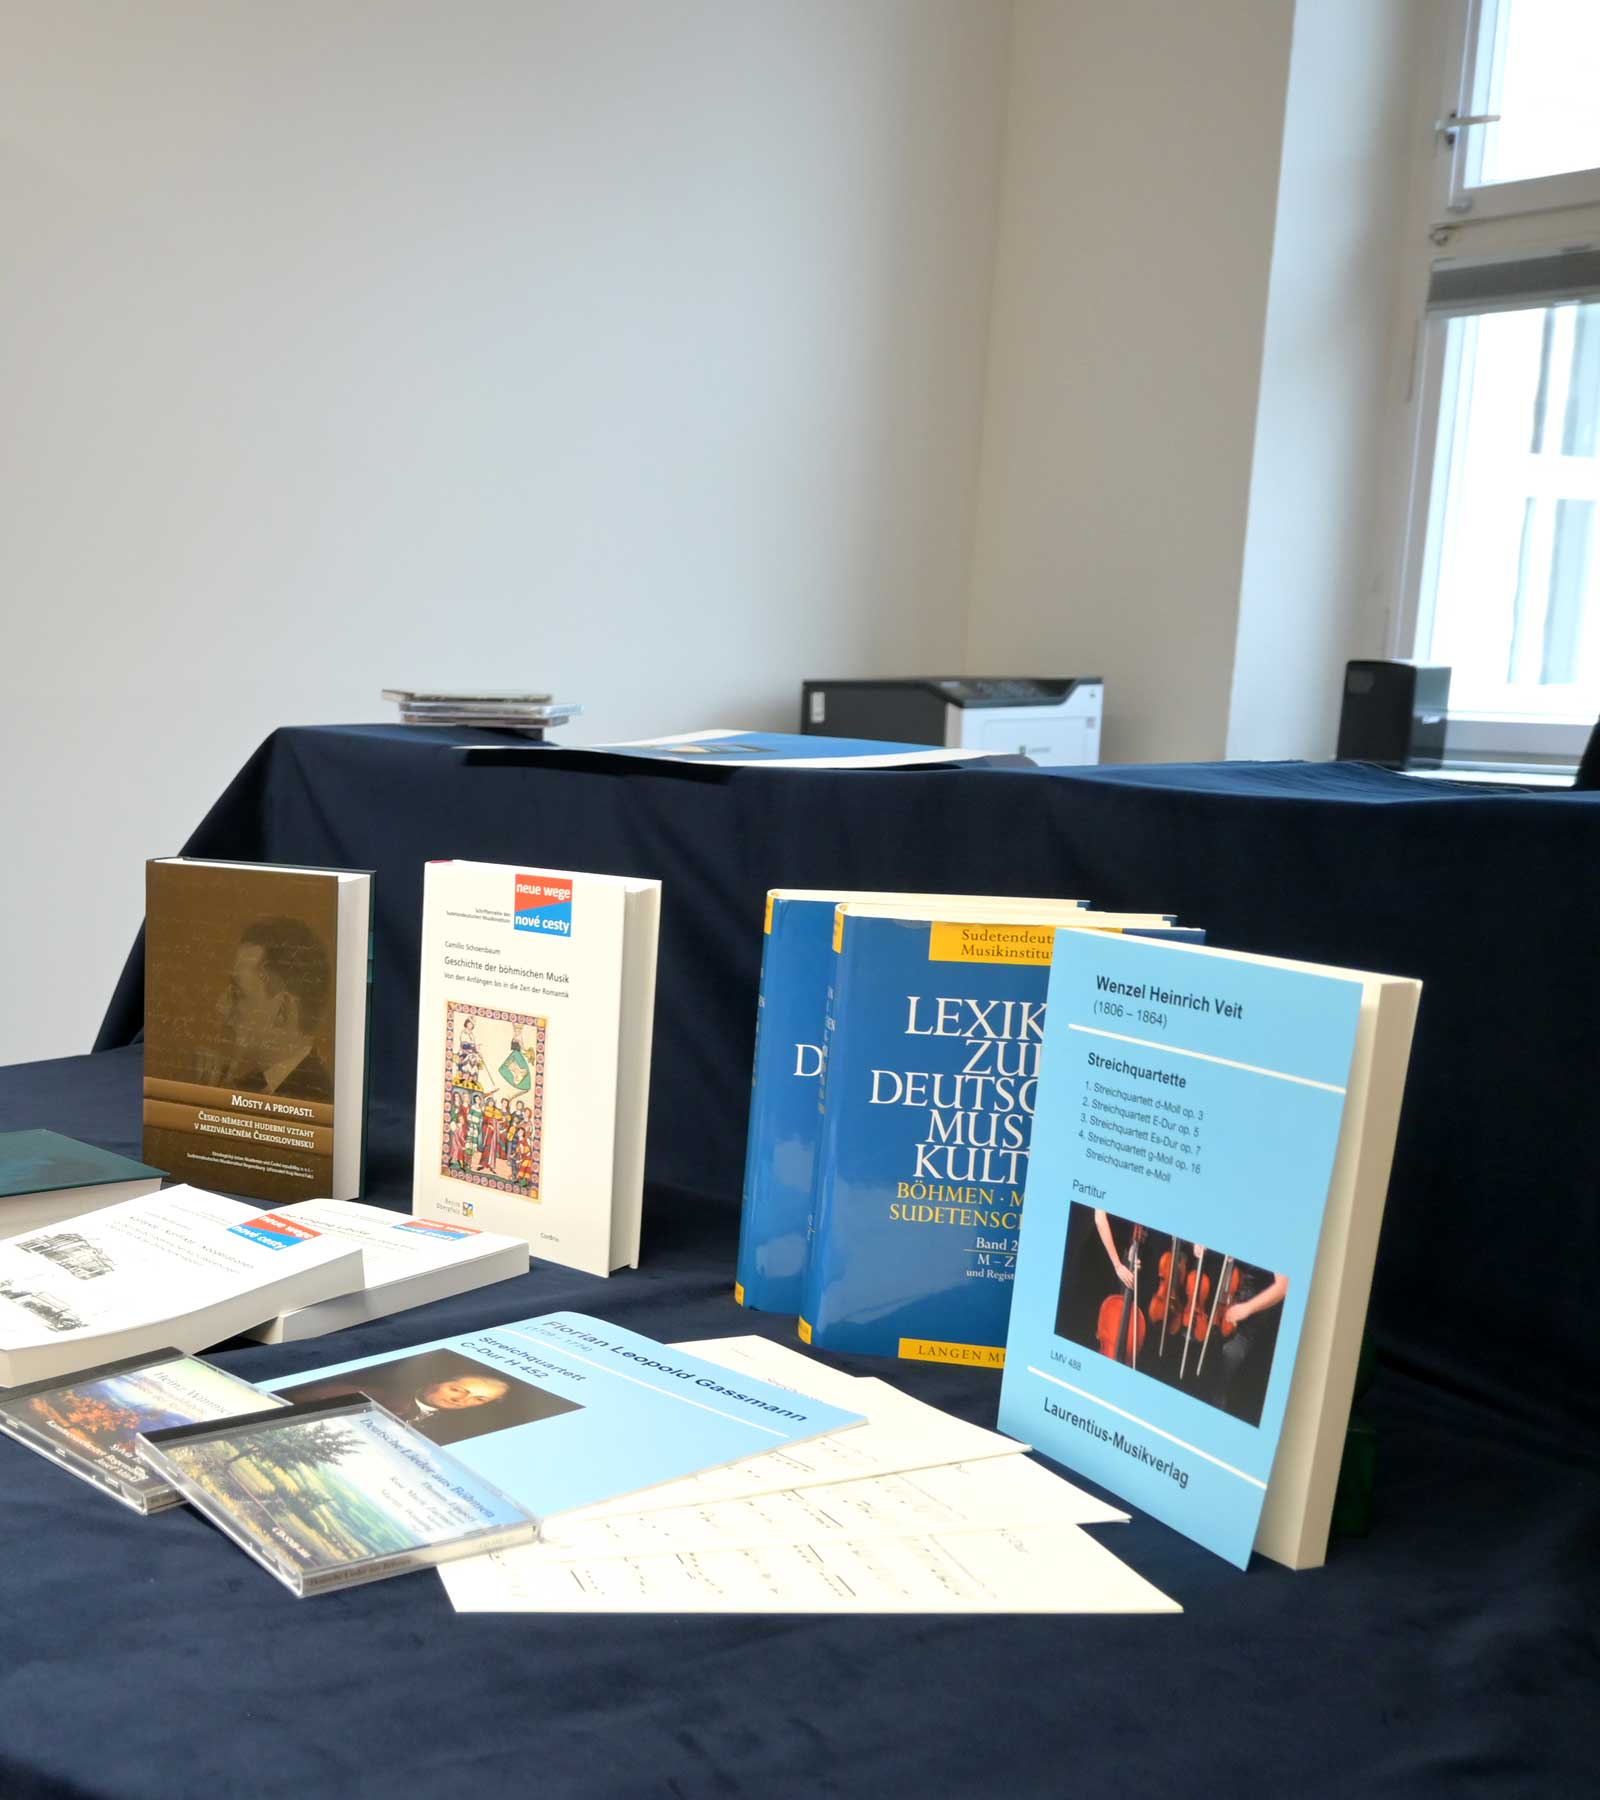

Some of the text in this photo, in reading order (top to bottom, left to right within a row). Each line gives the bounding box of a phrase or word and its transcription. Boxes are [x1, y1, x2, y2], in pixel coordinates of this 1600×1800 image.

[516, 884, 570, 901] neue wege
[515, 915, 569, 934] nové cesty
[444, 956, 570, 984] Geschichte der böhmischen Musik
[467, 976, 493, 987] Anfängen
[510, 982, 518, 990] die
[520, 984, 531, 992] Zeit
[531, 986, 541, 994] der
[542, 988, 569, 998] Romantik
[1096, 975, 1243, 1020] Wenzel Heinrich Veit
[904, 996, 1048, 1042] LEXIK
[1093, 999, 1124, 1018] (1806
[1136, 1009, 1168, 1030] 1864)
[1088, 1052, 1187, 1089] Streichquartette
[264, 1103, 272, 1112] A
[1082, 1096, 1199, 1138] 2. Streichquartett E-Dur op. 5
[1085, 1081, 1204, 1121] 1. Streichquartett d-Moll op. 3
[194, 1122, 200, 1130] V
[253, 1129, 315, 1149] ČESKOSLOVENSKU
[254, 1121, 286, 1134] HUDEBNÍ
[286, 1127, 315, 1138] VZTAHY
[925, 1109, 1034, 1149] MUS
[1080, 1112, 1087, 1123] 3.
[1090, 1115, 1149, 1140] Streichquartett
[1150, 1132, 1178, 1150] Es-Dur
[1180, 1143, 1193, 1154] op.
[913, 1143, 1030, 1185] KULT
[1078, 1129, 1201, 1175] 4. Streichquartett g-Moll op. 16
[1086, 1147, 1171, 1182] Streichquartett e-Moll
[897, 1179, 994, 1206] BÖHMEN
[1072, 1179, 1107, 1200] Partitur
[976, 1236, 1018, 1251] Band 2
[966, 1269, 985, 1279] und
[977, 1253, 990, 1266] M
[1004, 1256, 1016, 1268] Z
[460, 1341, 549, 1379] C-Dur H 452
[478, 1336, 587, 1381] Streichquartett
[918, 1345, 982, 1362] LANGEN
[1050, 1350, 1067, 1364] LMV
[543, 1321, 808, 1422] Florian Leopold Gassmann
[1043, 1396, 1189, 1489] Laurentius-Musikverlag
[360, 1418, 403, 1450] Deutsche
[400, 1448, 434, 1474] Lieder
[432, 1473, 451, 1488] aus
[451, 1485, 496, 1519] Böhmen
